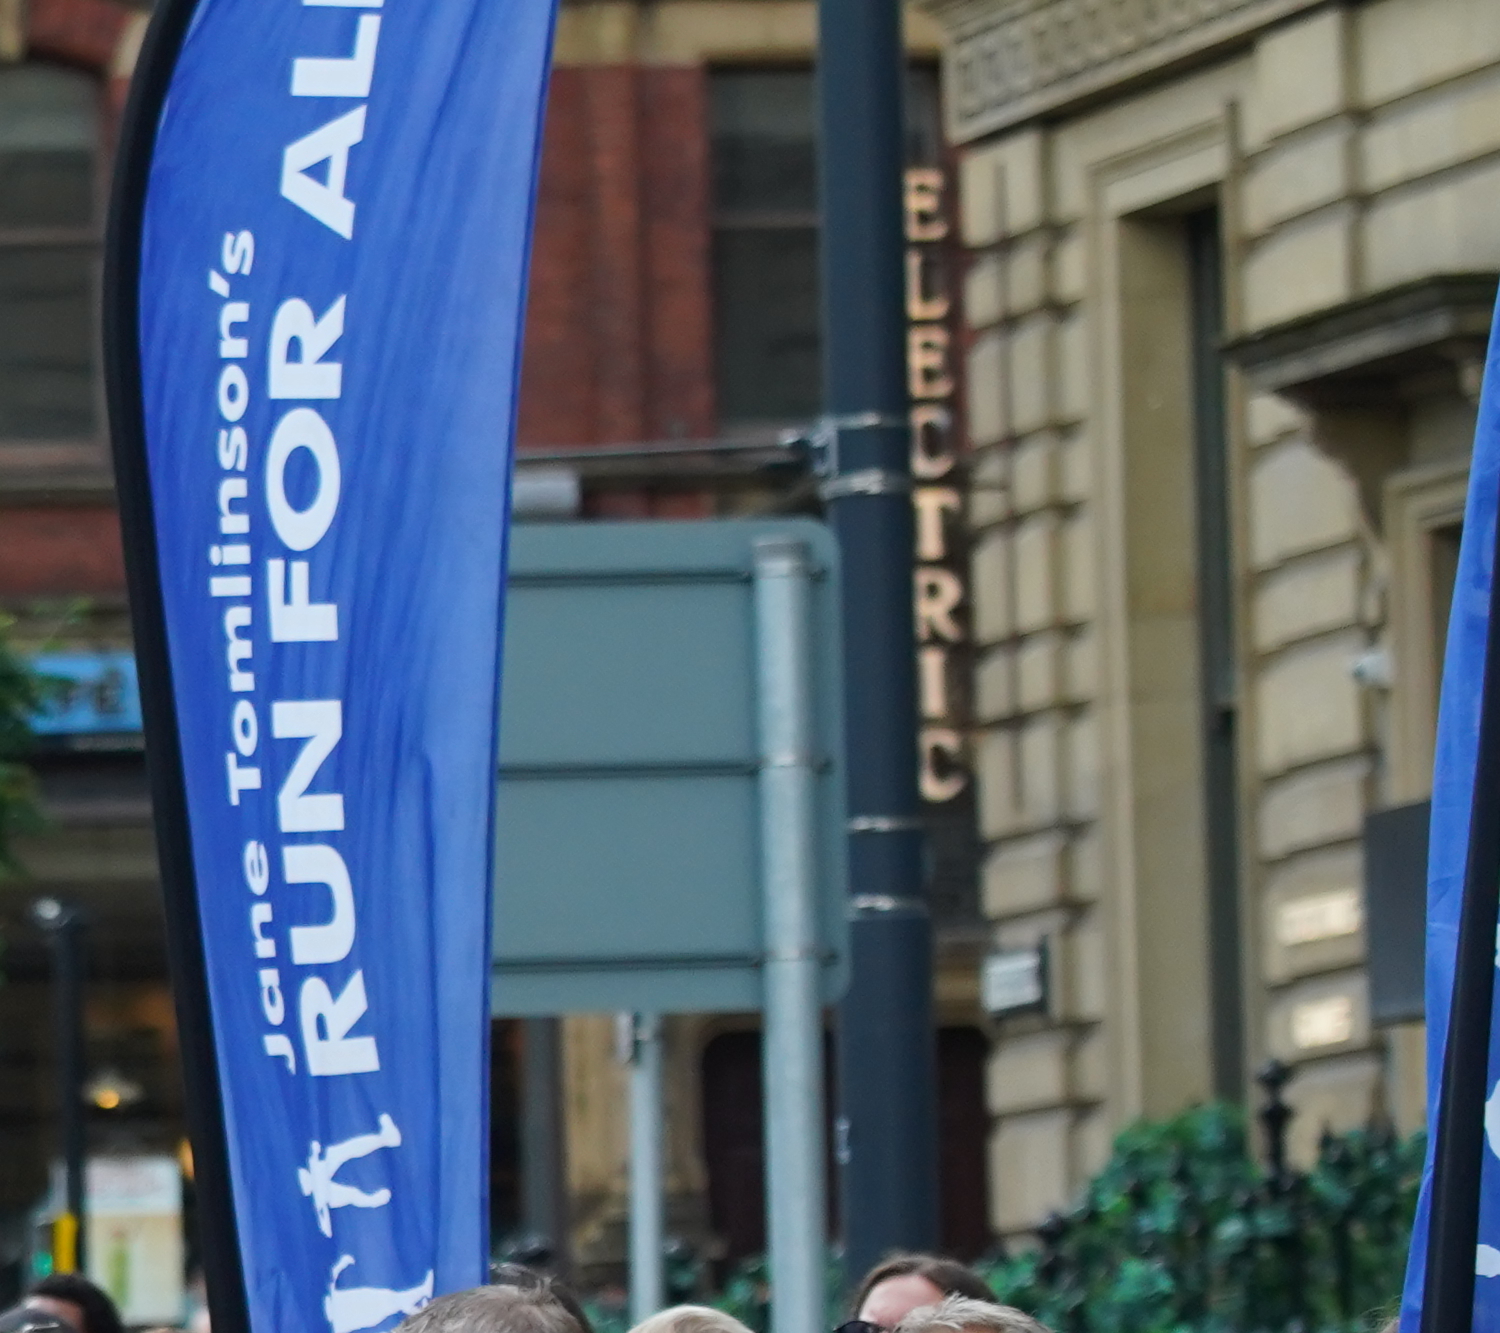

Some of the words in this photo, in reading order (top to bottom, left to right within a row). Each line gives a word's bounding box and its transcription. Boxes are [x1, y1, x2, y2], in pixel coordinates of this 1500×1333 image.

[280, 0, 385, 241] AL
[208, 228, 264, 806] Tomlinson's
[265, 295, 347, 643] FOR
[903, 168, 968, 802] ELECTRIC
[241, 840, 299, 1077] Jane
[272, 697, 382, 1078] RUN
